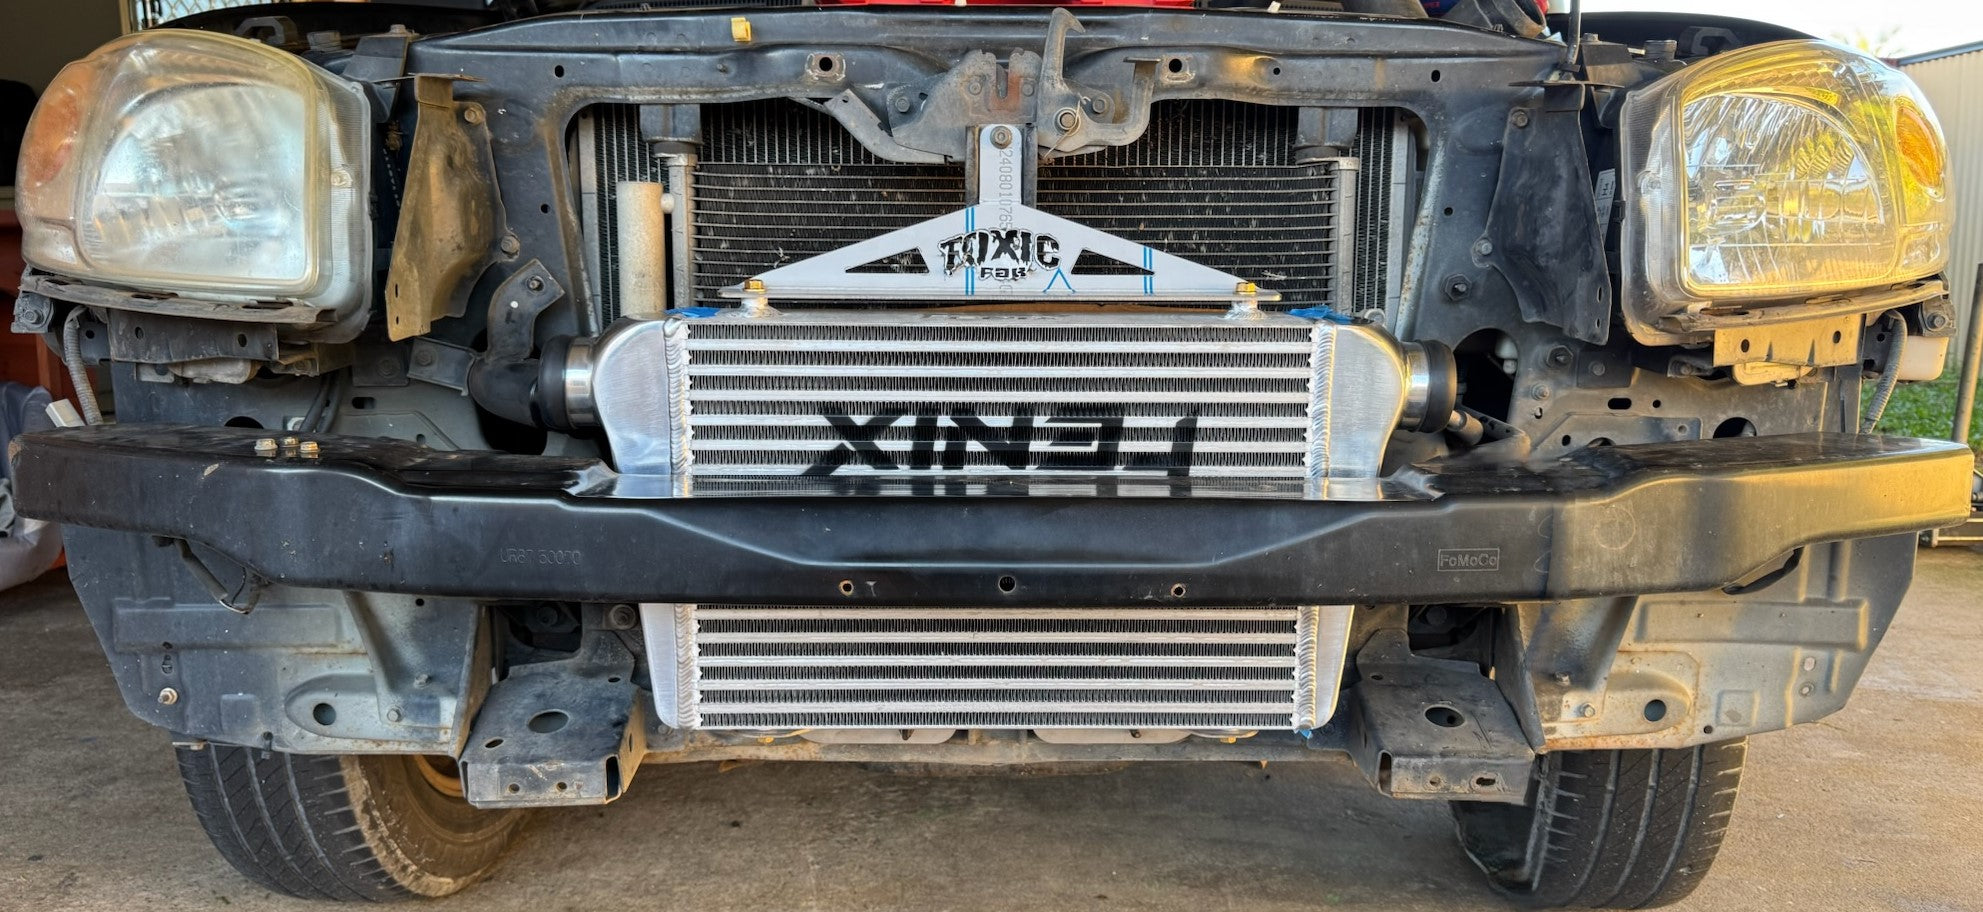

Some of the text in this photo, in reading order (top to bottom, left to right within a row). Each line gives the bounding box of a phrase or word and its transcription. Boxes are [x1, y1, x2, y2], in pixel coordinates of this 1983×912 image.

[938, 228, 1061, 276] TOXIC
[800, 404, 1198, 477] FENIX
[1440, 553, 1497, 567] FoMoCo
